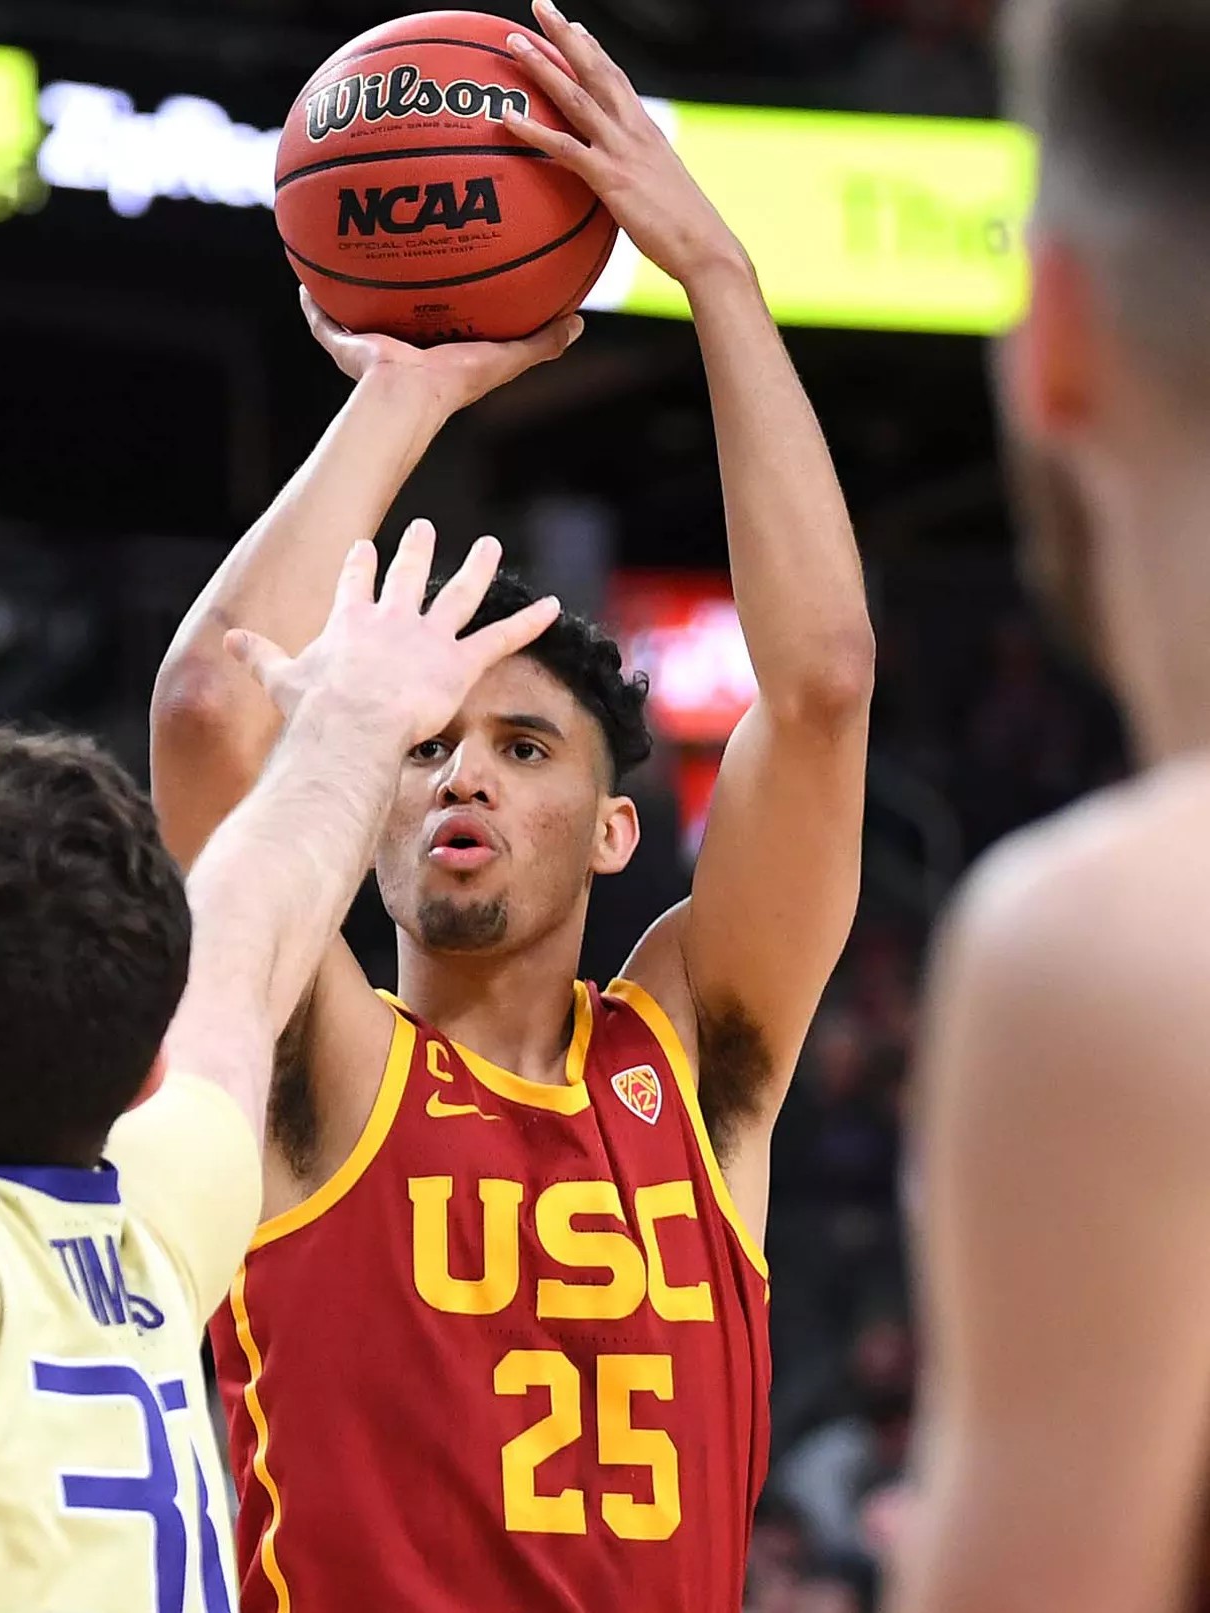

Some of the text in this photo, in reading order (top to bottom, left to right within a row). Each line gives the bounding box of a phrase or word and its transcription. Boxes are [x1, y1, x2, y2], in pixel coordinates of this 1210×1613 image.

[306, 64, 529, 144] Wilson
[443, 121, 473, 130] BALL
[337, 176, 502, 237] NCAA
[338, 230, 502, 250] OFFICIAL GAME BALL
[615, 1069, 658, 1106] PAC
[631, 1090, 657, 1113] 12
[407, 1175, 715, 1322] USC
[493, 1350, 682, 1541] 25
